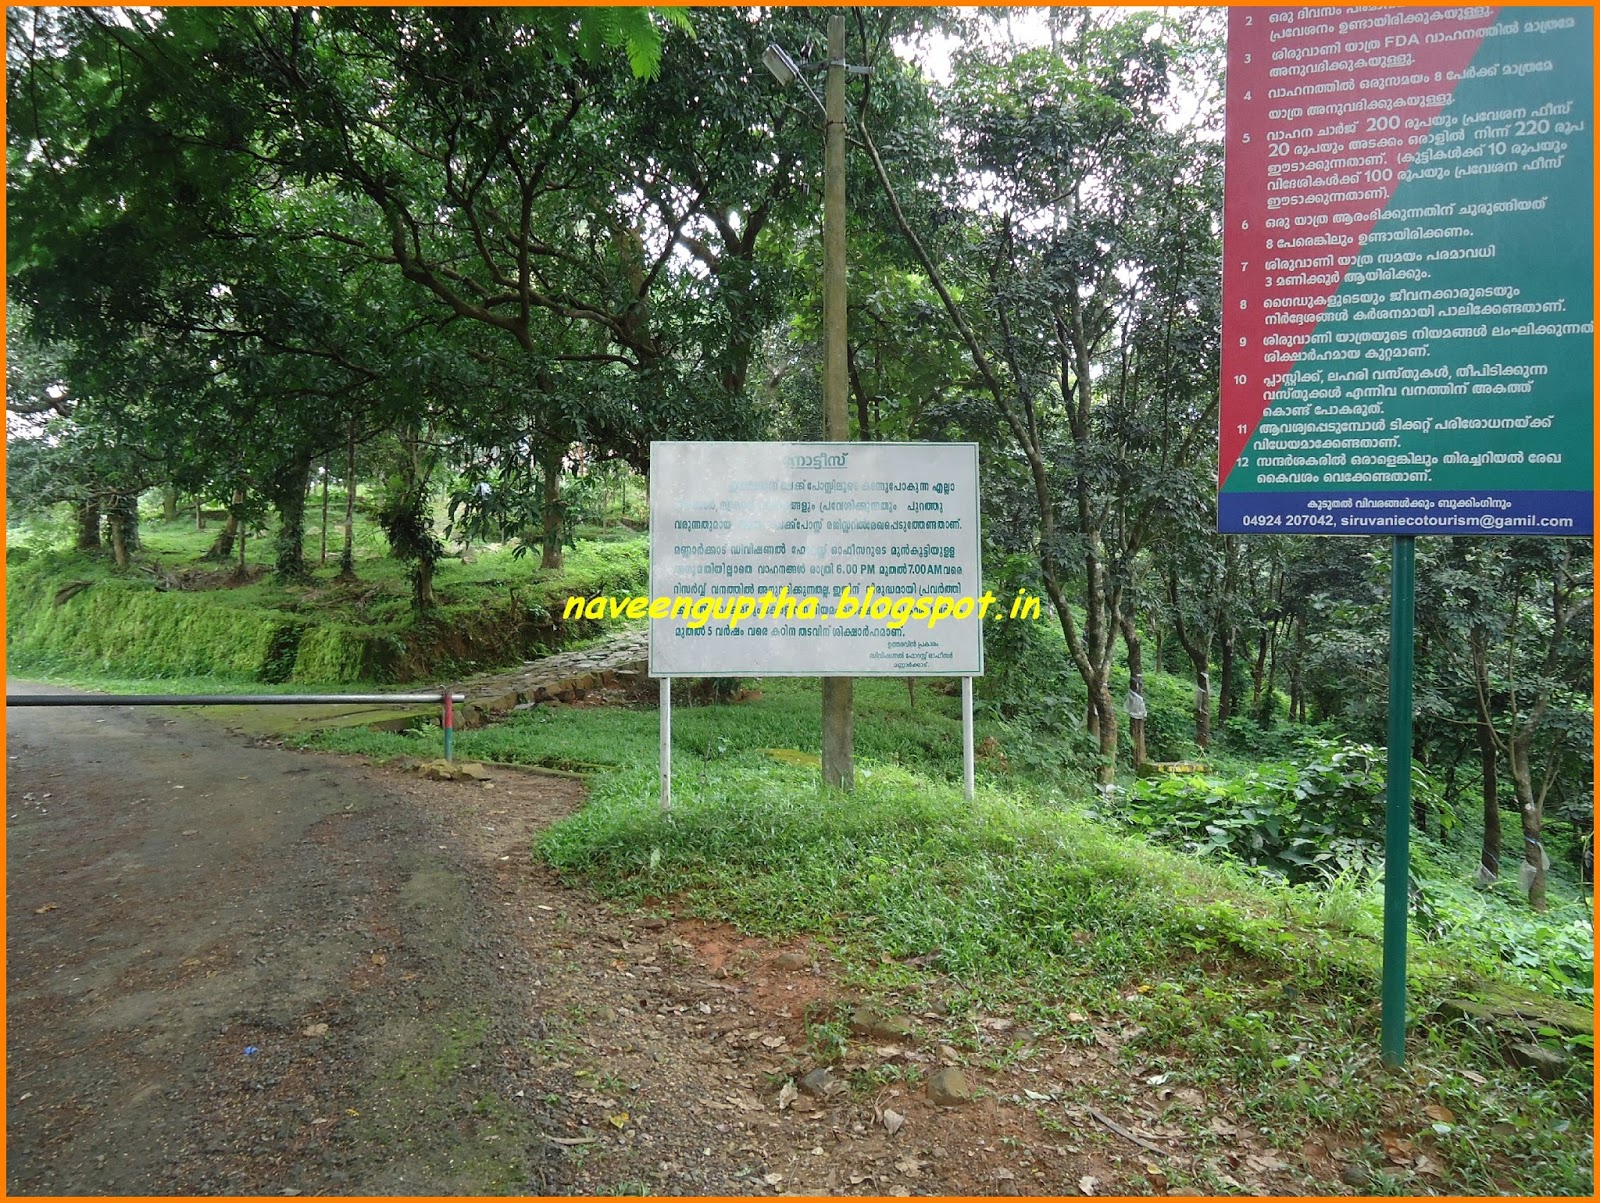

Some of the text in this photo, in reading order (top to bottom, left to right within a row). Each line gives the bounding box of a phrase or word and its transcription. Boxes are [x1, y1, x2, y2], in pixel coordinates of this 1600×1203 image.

[1245, 16, 1253, 26] 2
[1269, 12, 1294, 24] ഒരു
[1297, 7, 1343, 20] ദിവസം
[1244, 17, 1576, 64] 3 ശിരുവാണി യാത്ര FDA വാഹനത്തിൽ മാത്രമേ
[1270, 25, 1335, 42] പ്രവേശനം
[1243, 60, 1554, 101] 4 വാഹനത്തിൽ ഒരുസമയം 8 പേർക്ക് മാത്രമേ
[1242, 100, 1574, 143] 5 വാഹന ചാർജ് 200 രൂപയും പ്രവേശന ഫീസ്
[1268, 107, 1303, 121] യാത്ര
[1268, 119, 1585, 157] 20 രൂപയും അടക്കം ഒരാളിൽ നിന്ന് 220 രൂപ
[1488, 141, 1506, 155] 10
[1511, 140, 1568, 156] രൂപയും
[1267, 155, 1565, 191] വിദേശികൾക്ക് 100 രൂപയും പ്രവേശന ഫീസ്
[1241, 220, 1249, 230] 6
[1265, 218, 1291, 230] ഒരു
[1294, 214, 1329, 228] യാത്ര
[1458, 196, 1548, 217] ചുരുങ്ങിയത്
[1266, 239, 1274, 249] 8
[1276, 233, 1354, 249] പേരെങ്കിലും
[1241, 244, 1496, 272] 7 ശിരുവാണി യാത്ര സമയം പരമാവധി
[1265, 277, 1273, 287] 3
[1344, 267, 1432, 285] ആയിരിക്കും.
[1239, 300, 1247, 310] 8
[1353, 304, 1435, 321] കർശനമായി
[1239, 337, 1247, 347] 9
[1263, 330, 1333, 347] ശിരുവാണി
[1336, 329, 1408, 345] യാത്രയുടെ
[1412, 324, 1488, 339] നിയമങ്ങൾ
[1264, 348, 1361, 363] ശിക്ഷാർഹമായ
[1233, 374, 1247, 385] 10
[1327, 367, 1369, 381] ലഹരി
[1456, 363, 1548, 379] തീപിടിക്കുന്ന
[1345, 384, 1397, 398] എന്നിവ
[1401, 382, 1470, 396] വനത്തിന്
[1472, 380, 1534, 394] അകത്ത്
[1262, 401, 1384, 417] കൊണ്ട് പോകരുത്.
[1237, 424, 1247, 434] 11
[1389, 417, 1433, 434] ടിക്കറ്റ്
[1236, 457, 1249, 468] 12
[1528, 453, 1562, 464] രേഖ
[1256, 472, 1319, 484] കൈവശം
[1242, 514, 1573, 529] 04924 207042, siruvaniecotourism@gamil.com
[836, 564, 858, 575] 6.00
[860, 564, 875, 575] PM
[707, 626, 712, 636] 5
